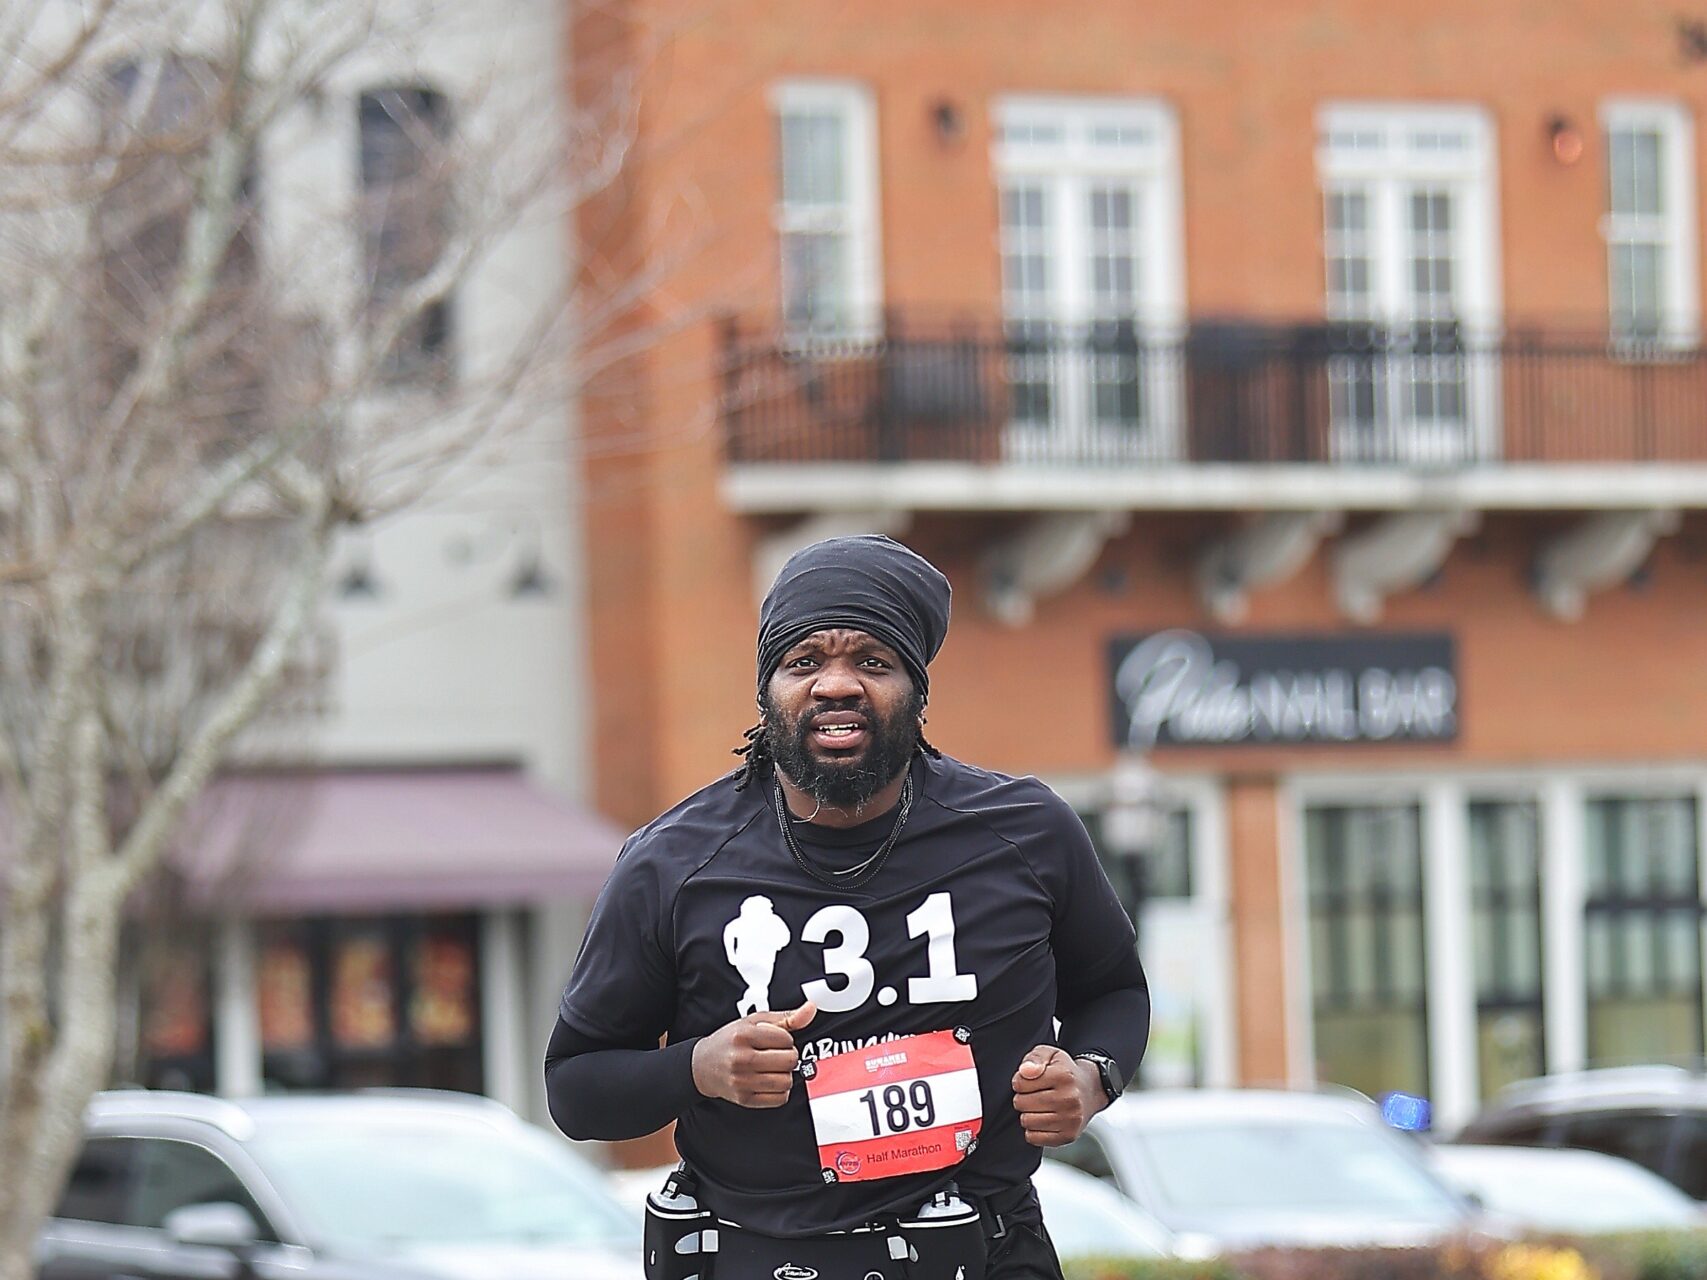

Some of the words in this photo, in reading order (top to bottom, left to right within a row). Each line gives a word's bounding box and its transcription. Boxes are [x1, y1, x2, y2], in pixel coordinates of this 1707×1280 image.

[1358, 668, 1457, 740] BAR
[860, 1080, 936, 1136] 189
[866, 1151, 889, 1163] Half
[891, 1144, 942, 1160] Marathon
